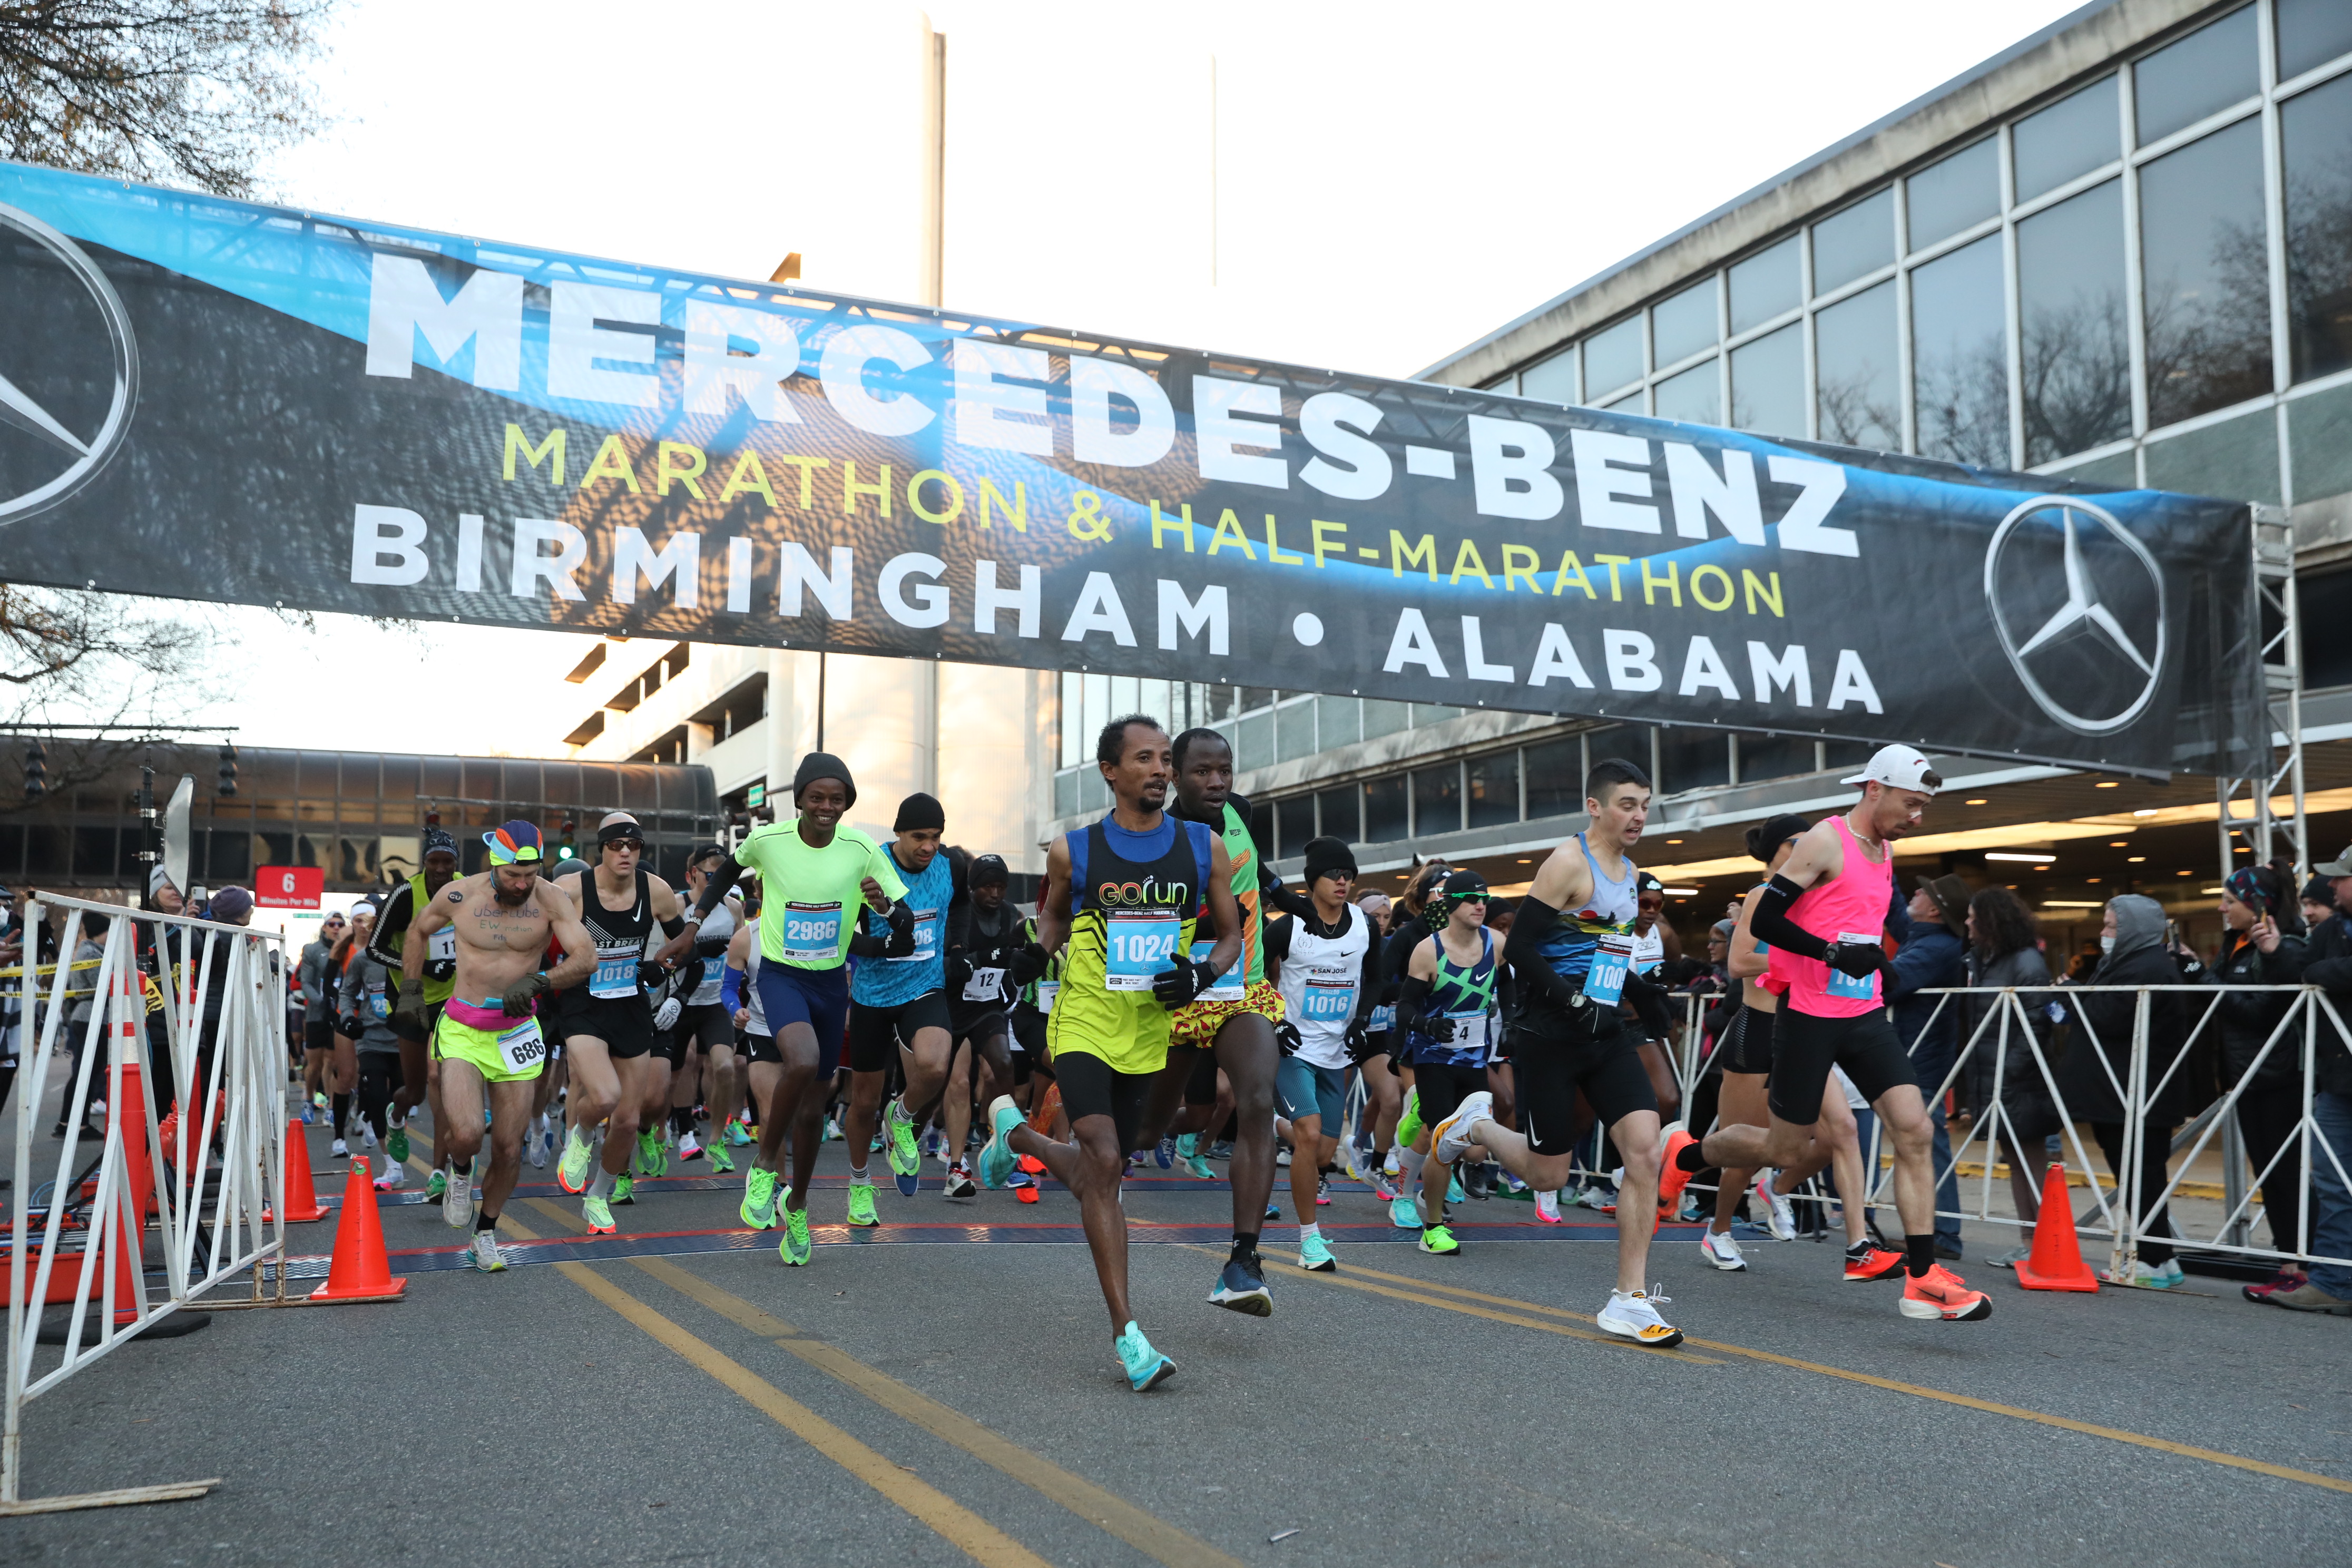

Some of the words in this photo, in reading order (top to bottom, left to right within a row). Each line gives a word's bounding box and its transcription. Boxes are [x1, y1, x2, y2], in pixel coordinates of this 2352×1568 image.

[366, 253, 1859, 557] MERCEDES-BENZ
[503, 423, 1027, 533] MARATHON
[1067, 489, 1114, 543] &
[1150, 498, 1785, 618] HALF-MARATHON
[351, 503, 1229, 655] BIRMINGHAM
[1383, 607, 1884, 714] ALABAMA
[282, 873, 296, 893] 6
[260, 896, 288, 905] Minutes
[290, 897, 302, 906] Per
[303, 898, 318, 907] Mile
[787, 920, 837, 940] 2986
[1114, 934, 1174, 962] 1024
[595, 965, 635, 983] 1018
[980, 973, 995, 987] 12
[1307, 995, 1349, 1013] 1016
[512, 1035, 527, 1044] OWEN
[1459, 1026, 1469, 1040] 4
[511, 1038, 545, 1064] 686
